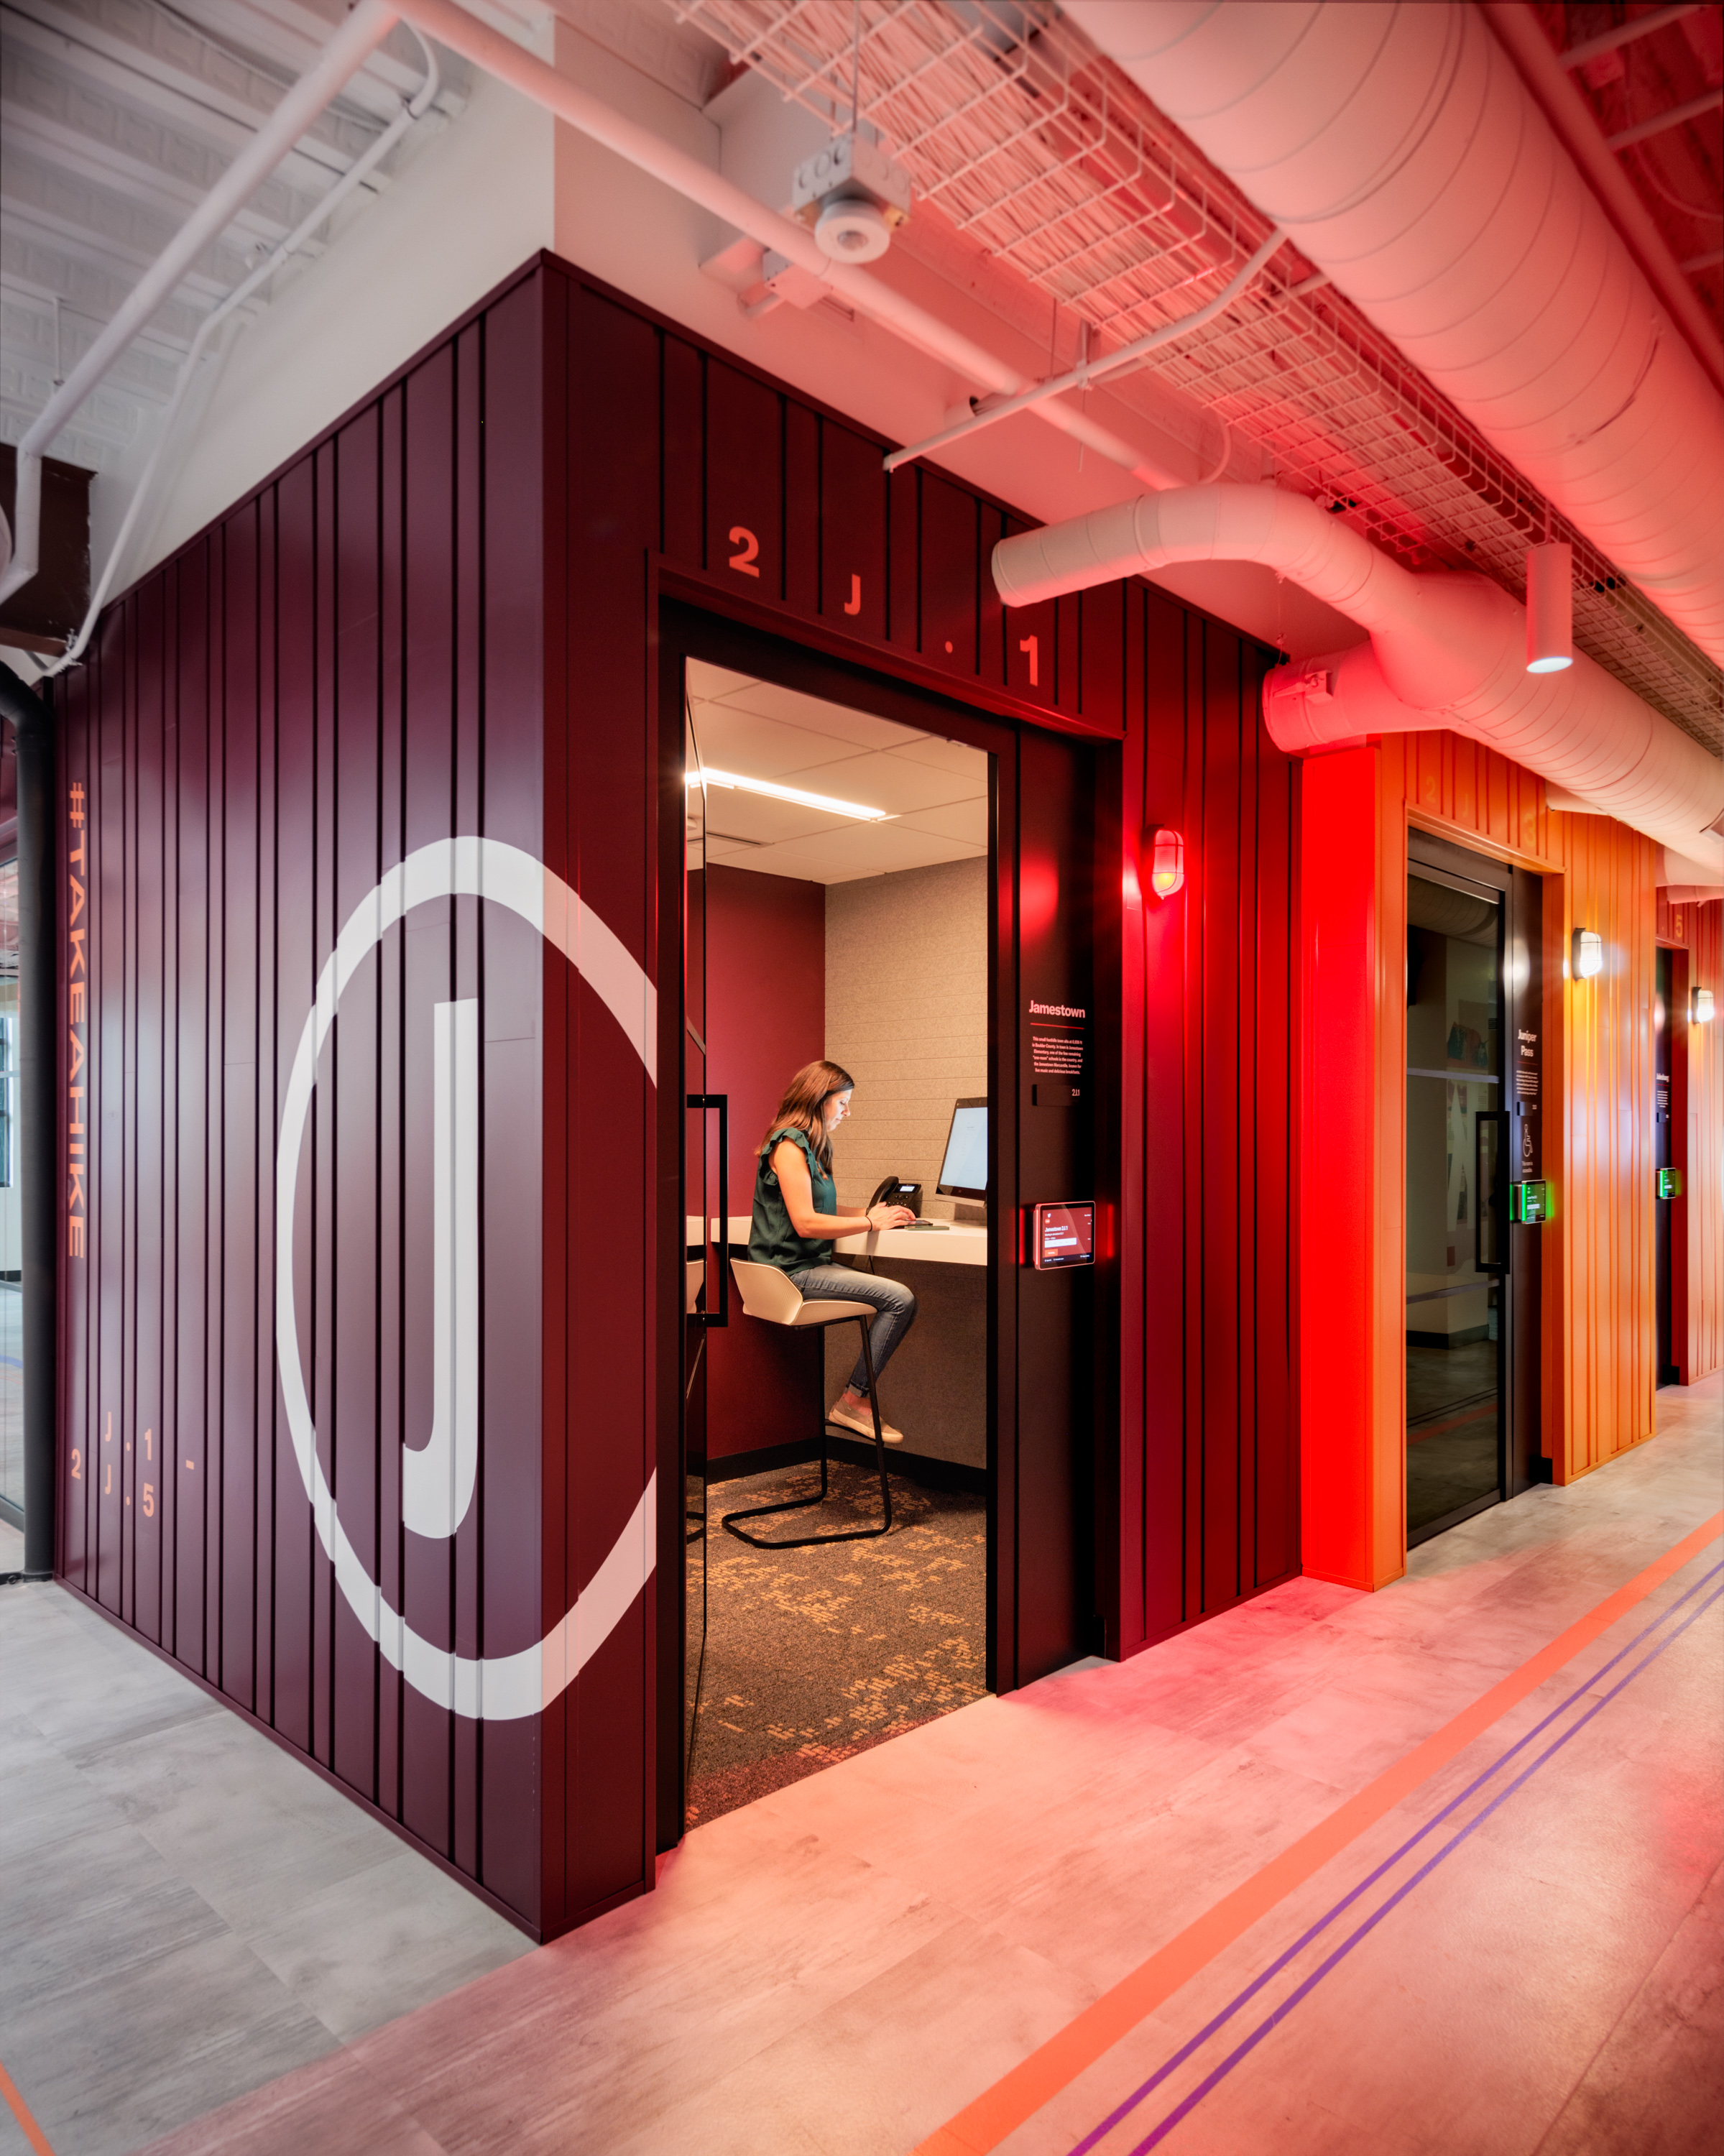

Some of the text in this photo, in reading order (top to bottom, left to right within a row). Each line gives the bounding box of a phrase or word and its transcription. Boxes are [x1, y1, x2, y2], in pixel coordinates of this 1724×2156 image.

[1029, 1000, 1086, 1018] Jamestown
[69, 782, 85, 1259] #TAKEAHIKE
[1518, 1028, 1537, 1044] Juniper
[1521, 1045, 1534, 1057] Pass
[402, 998, 479, 1539] J
